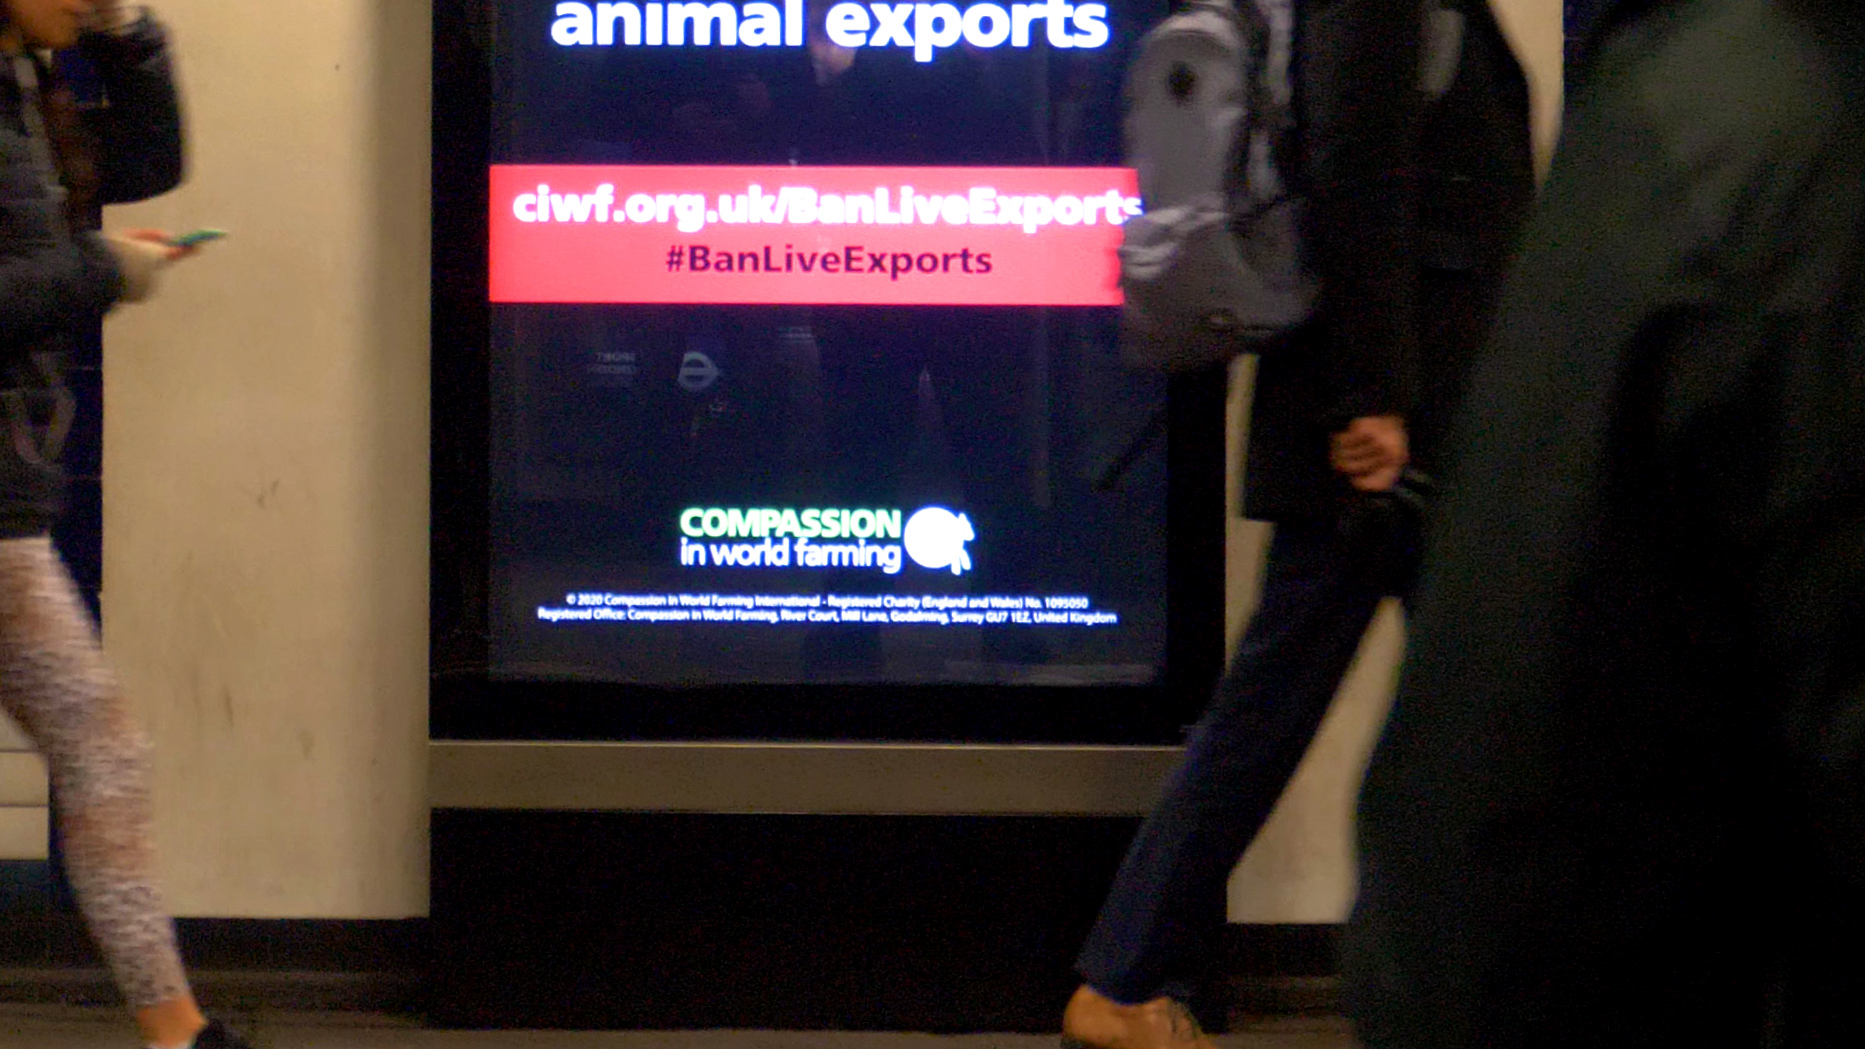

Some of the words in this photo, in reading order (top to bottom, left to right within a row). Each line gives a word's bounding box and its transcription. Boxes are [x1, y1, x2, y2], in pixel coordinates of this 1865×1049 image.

[512, 183, 1143, 234] ciwf.org.uk/BanLiveExports
[665, 244, 994, 281] #BanLiveExports
[680, 507, 902, 539] COMPASSION
[680, 536, 706, 566] in
[709, 536, 790, 567] world
[793, 536, 903, 574] farming
[537, 607, 592, 621] Registered
[627, 609, 689, 622] Compassion
[702, 610, 734, 622] World
[781, 610, 806, 622] River
[951, 611, 984, 625] Surrey
[985, 612, 1008, 624] GU7
[1033, 612, 1068, 625] United
[1070, 612, 1117, 626] Kingdom
[577, 594, 603, 606] 2020
[604, 594, 666, 608] Compassion
[679, 595, 710, 607] World
[711, 595, 754, 609] Farming
[755, 595, 820, 608] International
[828, 596, 882, 610] Registered
[883, 596, 920, 610] Charity
[921, 596, 967, 610] (England
[969, 597, 989, 609] and
[990, 597, 1023, 610] Wales)
[1025, 597, 1042, 609] No.
